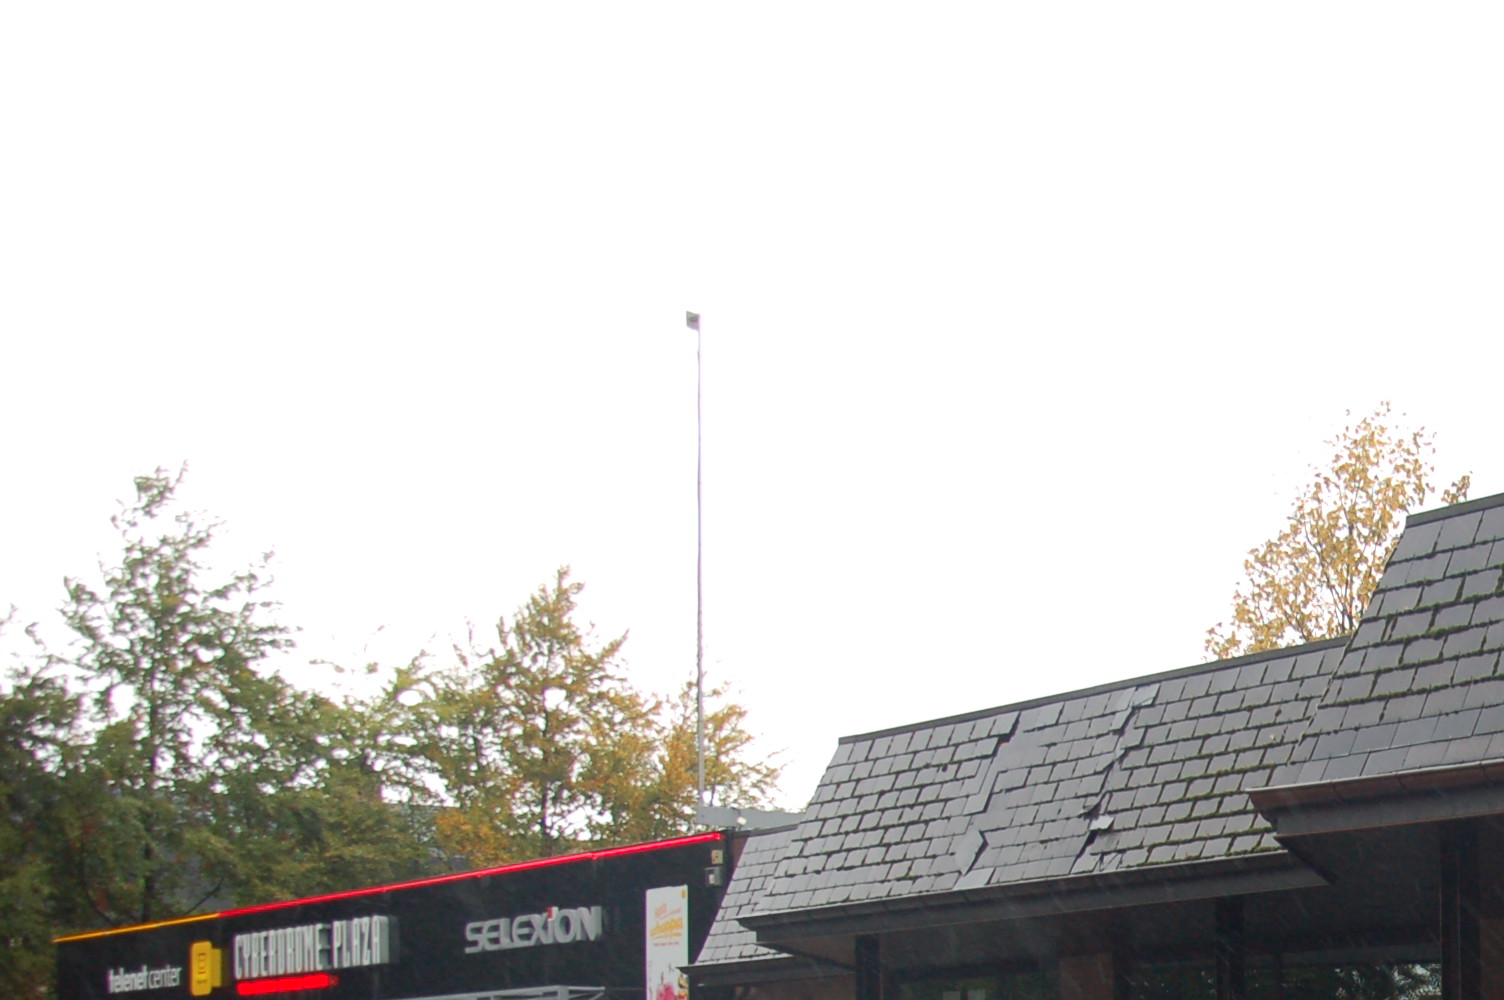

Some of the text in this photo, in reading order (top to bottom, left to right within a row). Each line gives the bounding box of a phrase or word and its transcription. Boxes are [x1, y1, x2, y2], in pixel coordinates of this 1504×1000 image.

[234, 915, 388, 980] CYBERDROME PLAZA
[108, 965, 182, 993] telenet center
